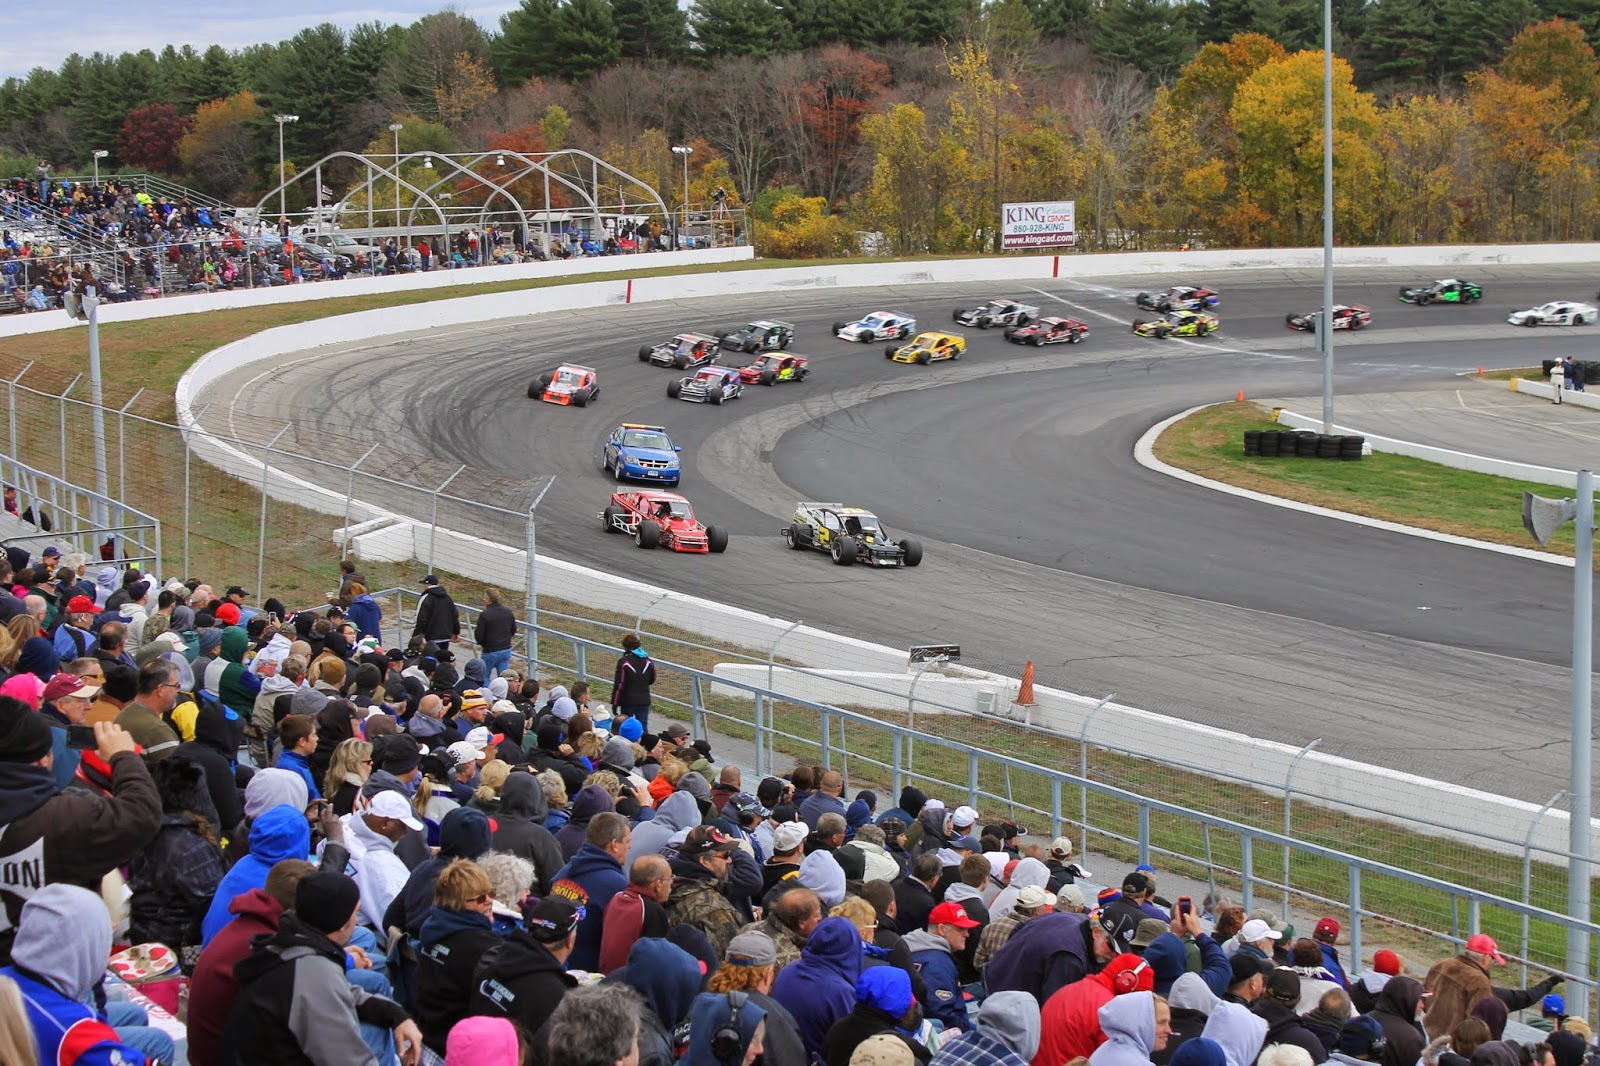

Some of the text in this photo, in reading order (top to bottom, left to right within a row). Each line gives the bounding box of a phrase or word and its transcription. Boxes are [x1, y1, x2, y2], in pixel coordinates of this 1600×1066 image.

[1006, 206, 1045, 225] KING
[1047, 214, 1071, 222] GMC
[1013, 223, 1064, 233] 860-928-KING
[1004, 234, 1073, 245] www.kingcad.com
